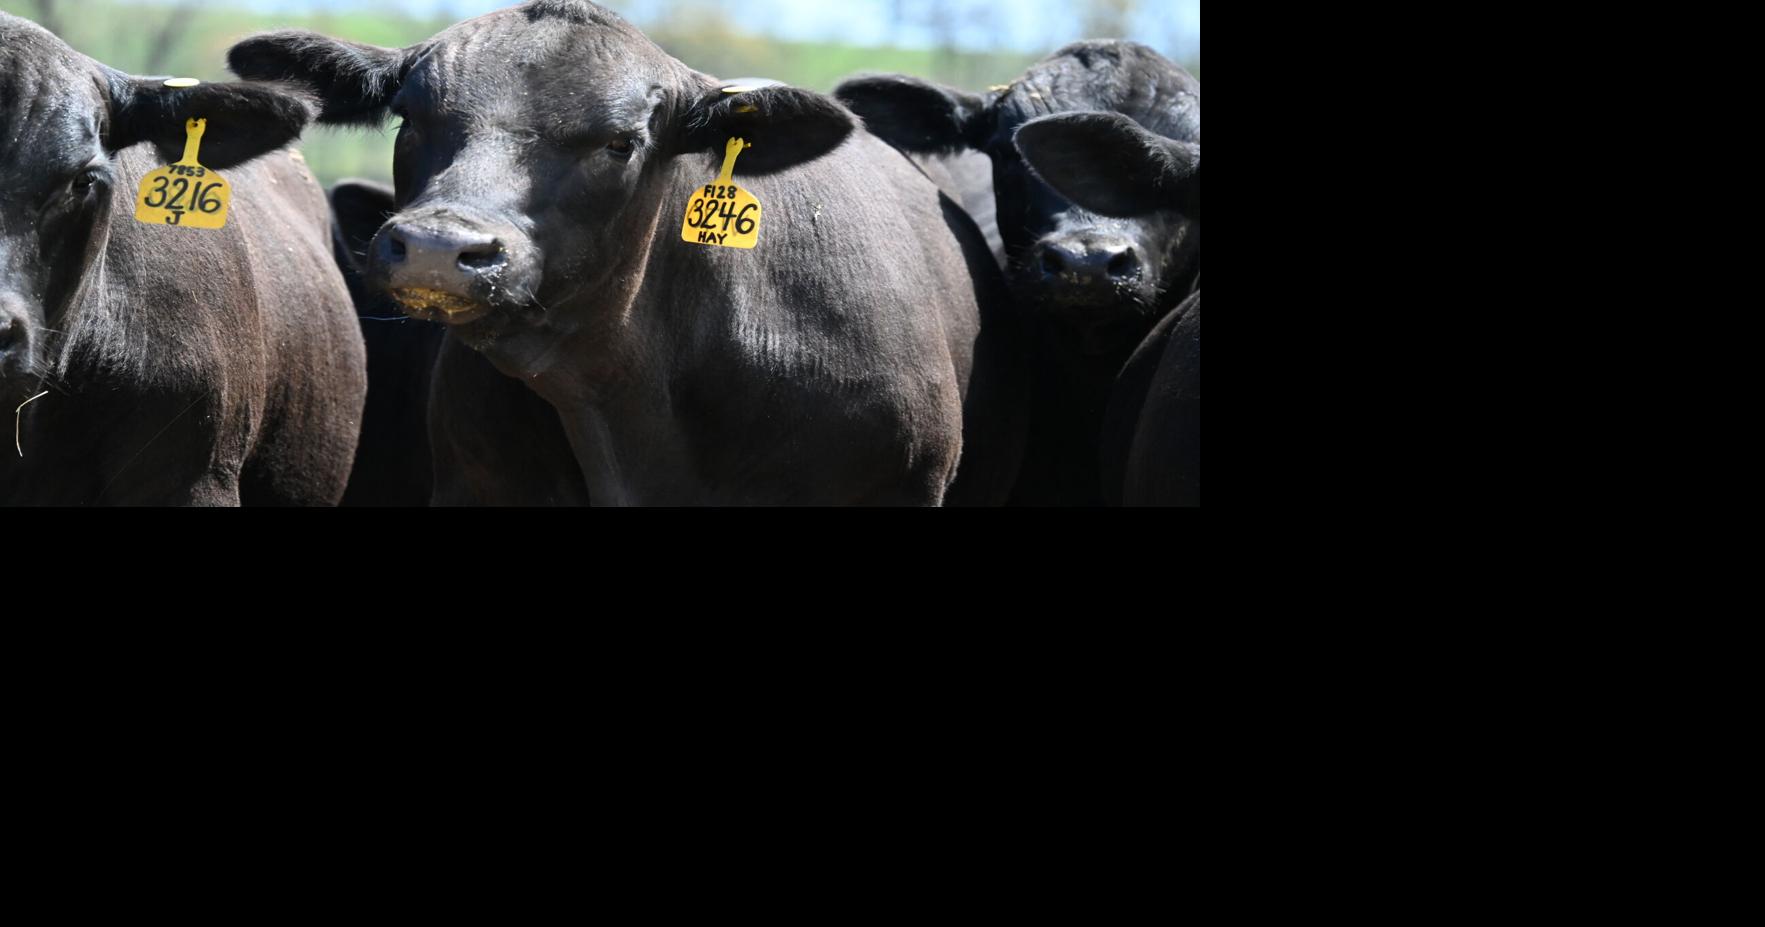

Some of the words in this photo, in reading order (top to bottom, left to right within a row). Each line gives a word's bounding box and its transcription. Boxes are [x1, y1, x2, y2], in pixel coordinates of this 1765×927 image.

[144, 176, 223, 213] 3216
[165, 211, 185, 225] J
[687, 198, 758, 234] 3246
[697, 231, 728, 245] HAY
